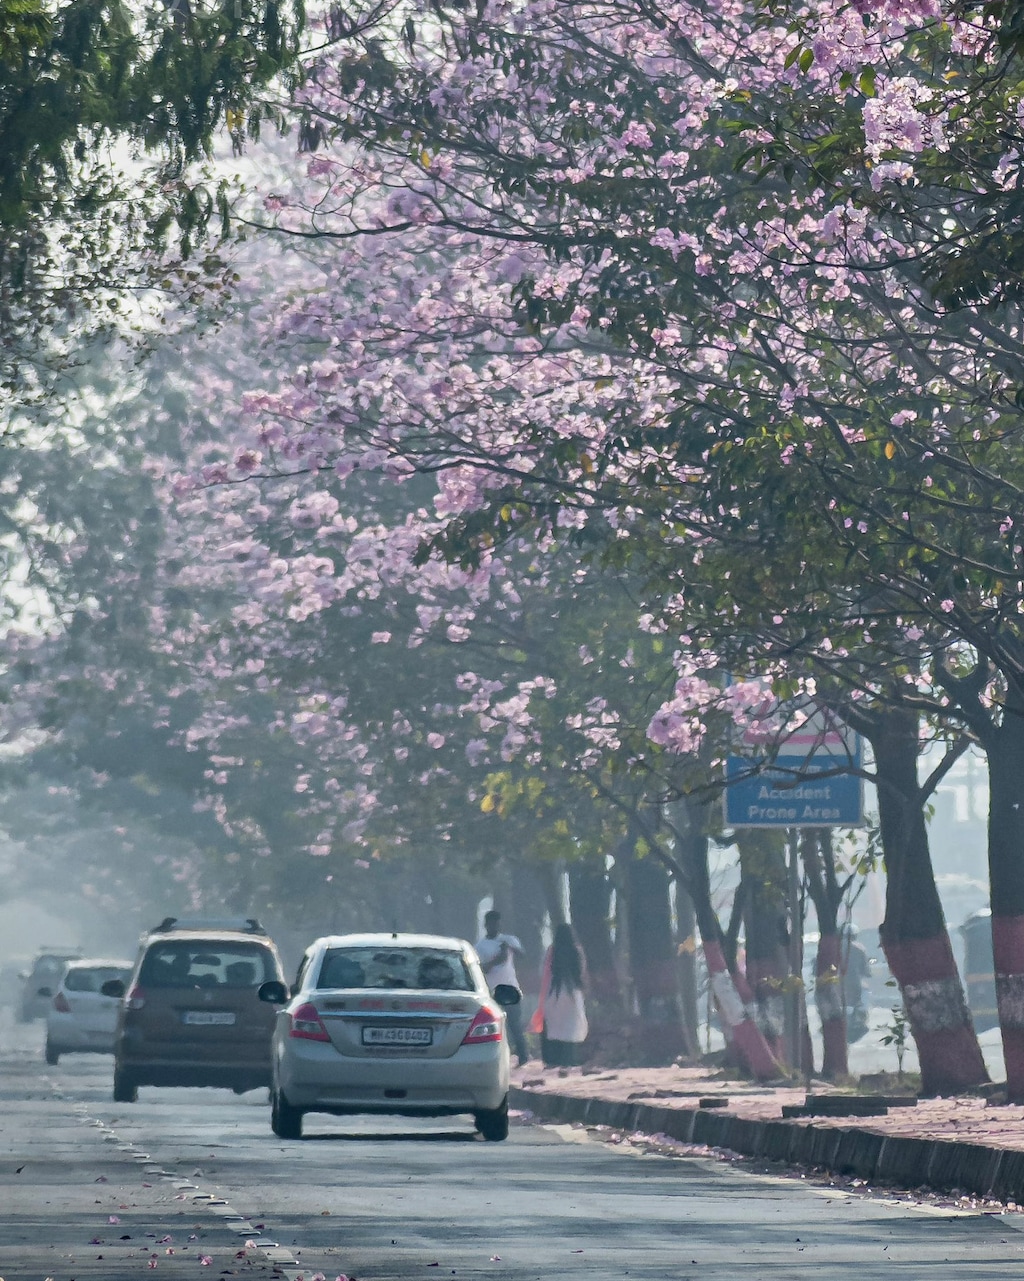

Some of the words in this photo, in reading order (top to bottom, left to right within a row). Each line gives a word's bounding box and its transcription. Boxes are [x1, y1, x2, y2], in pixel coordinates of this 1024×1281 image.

[758, 785, 832, 800] Accident
[748, 805, 797, 819] Prone
[802, 804, 840, 819] Area
